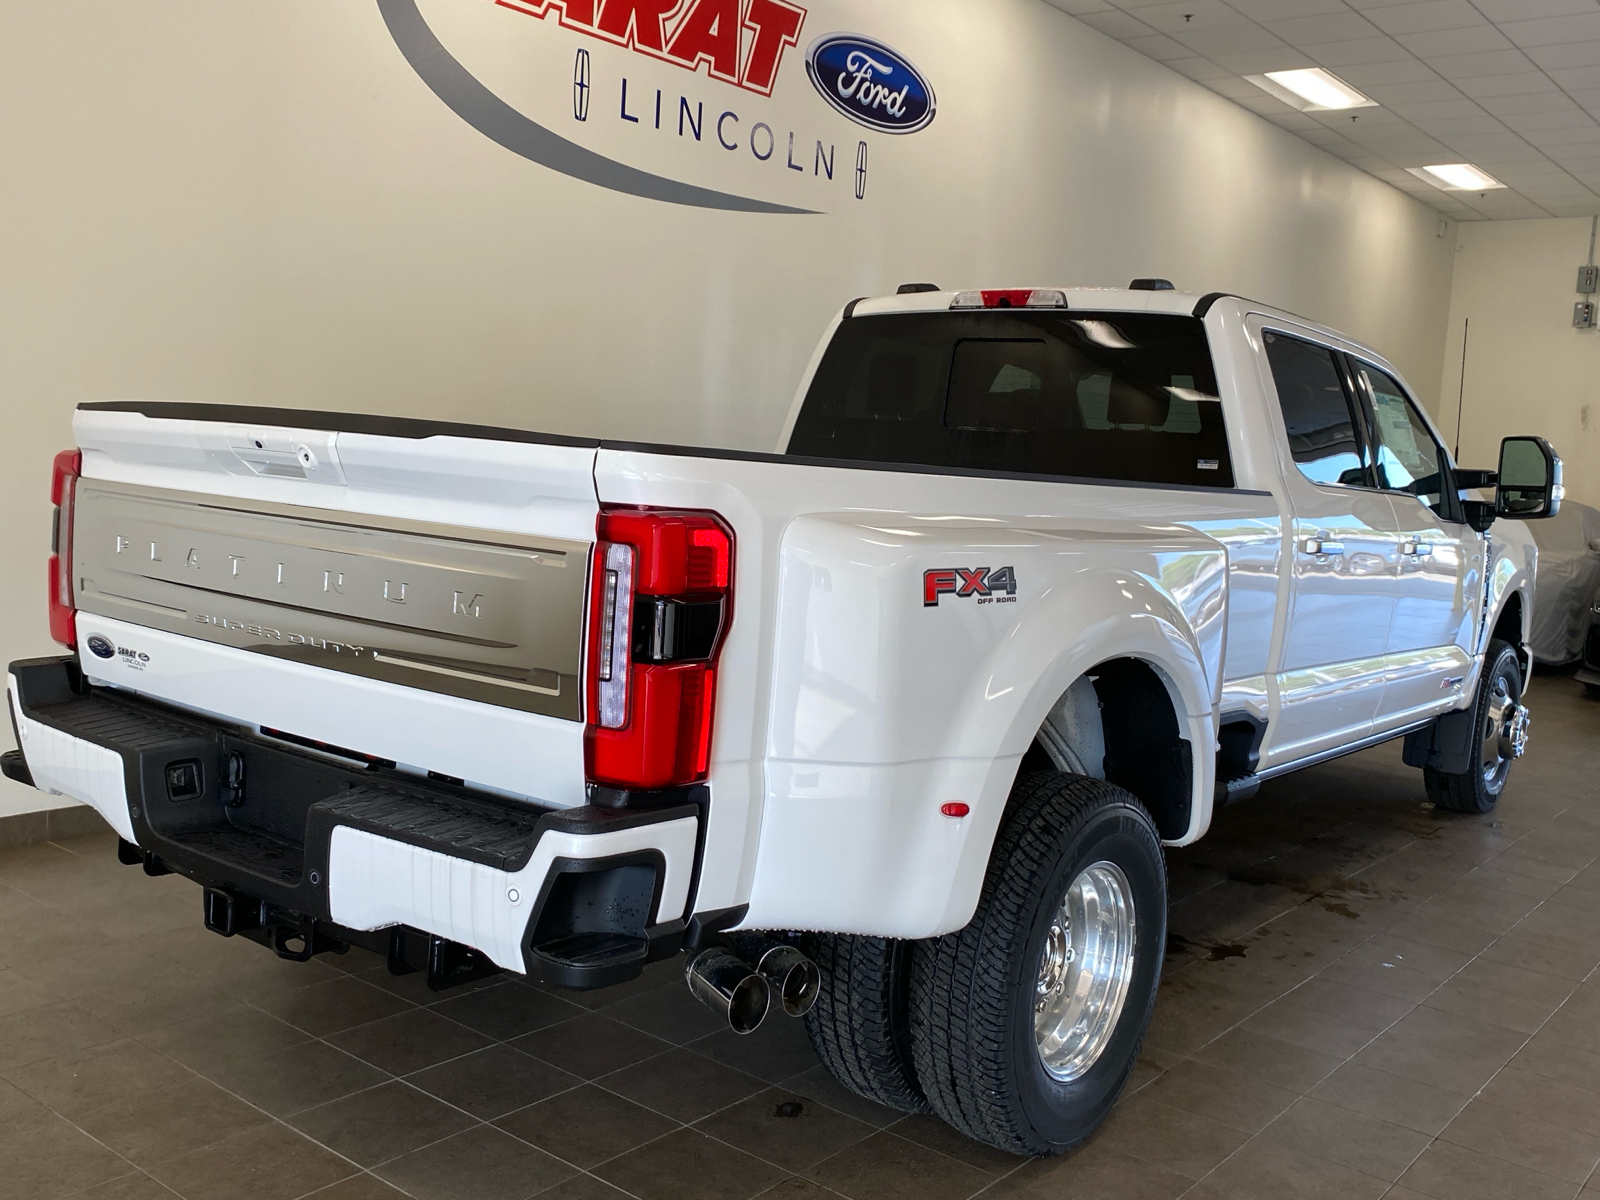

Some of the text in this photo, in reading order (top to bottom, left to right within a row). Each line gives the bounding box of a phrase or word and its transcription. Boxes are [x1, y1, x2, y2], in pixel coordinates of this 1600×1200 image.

[494, 0, 808, 98] RAT
[837, 50, 907, 118] Ford
[620, 78, 835, 180] LINCOLN
[116, 534, 484, 619] PLATINUM
[923, 566, 1017, 607] FX4
[117, 646, 137, 659] SARAT
[122, 656, 147, 668] LINCOLN
[195, 613, 364, 656] SUPER DUTY
